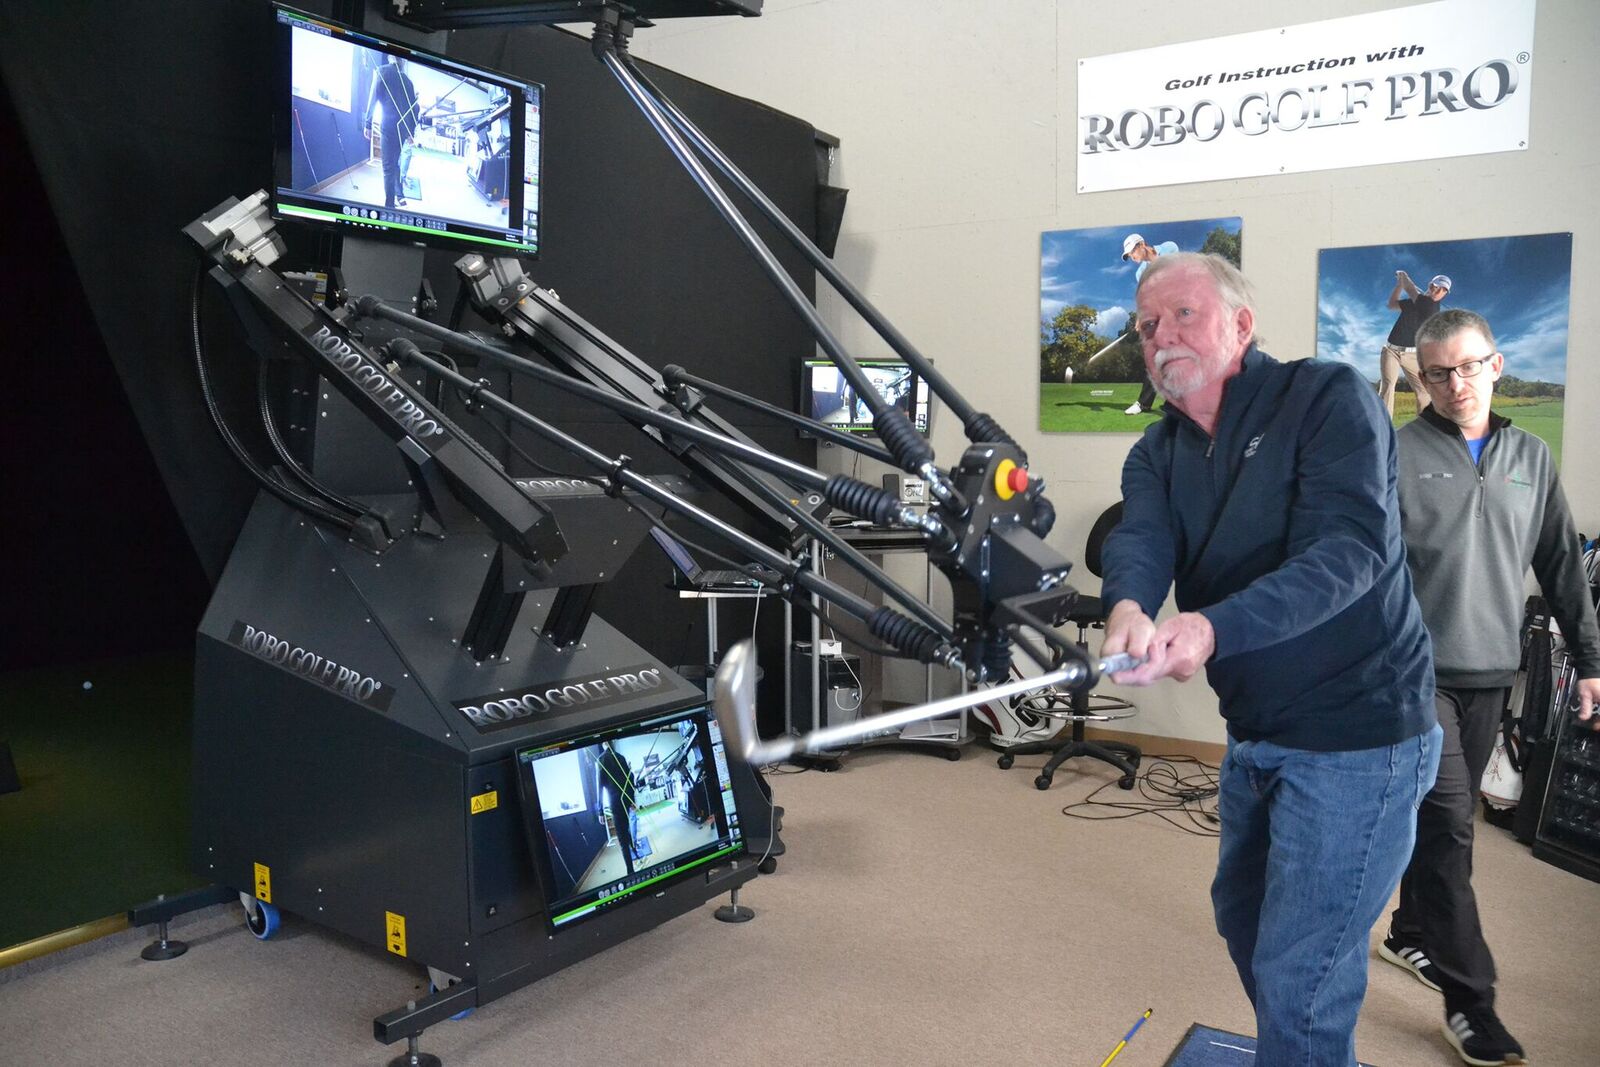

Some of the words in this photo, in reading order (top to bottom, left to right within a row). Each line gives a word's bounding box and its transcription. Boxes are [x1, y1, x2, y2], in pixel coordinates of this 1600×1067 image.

[1165, 74, 1212, 91] Golf
[1218, 56, 1356, 84] Instruction
[1366, 44, 1425, 63] with
[1080, 99, 1225, 155] ROBO
[1232, 77, 1375, 136] GOLF
[309, 325, 361, 372] ROBO
[354, 365, 404, 406] GOLF
[240, 624, 289, 665] ROBO
[288, 647, 337, 684] GOLF
[458, 693, 550, 727] ROBO
[545, 679, 611, 709] GOLF
